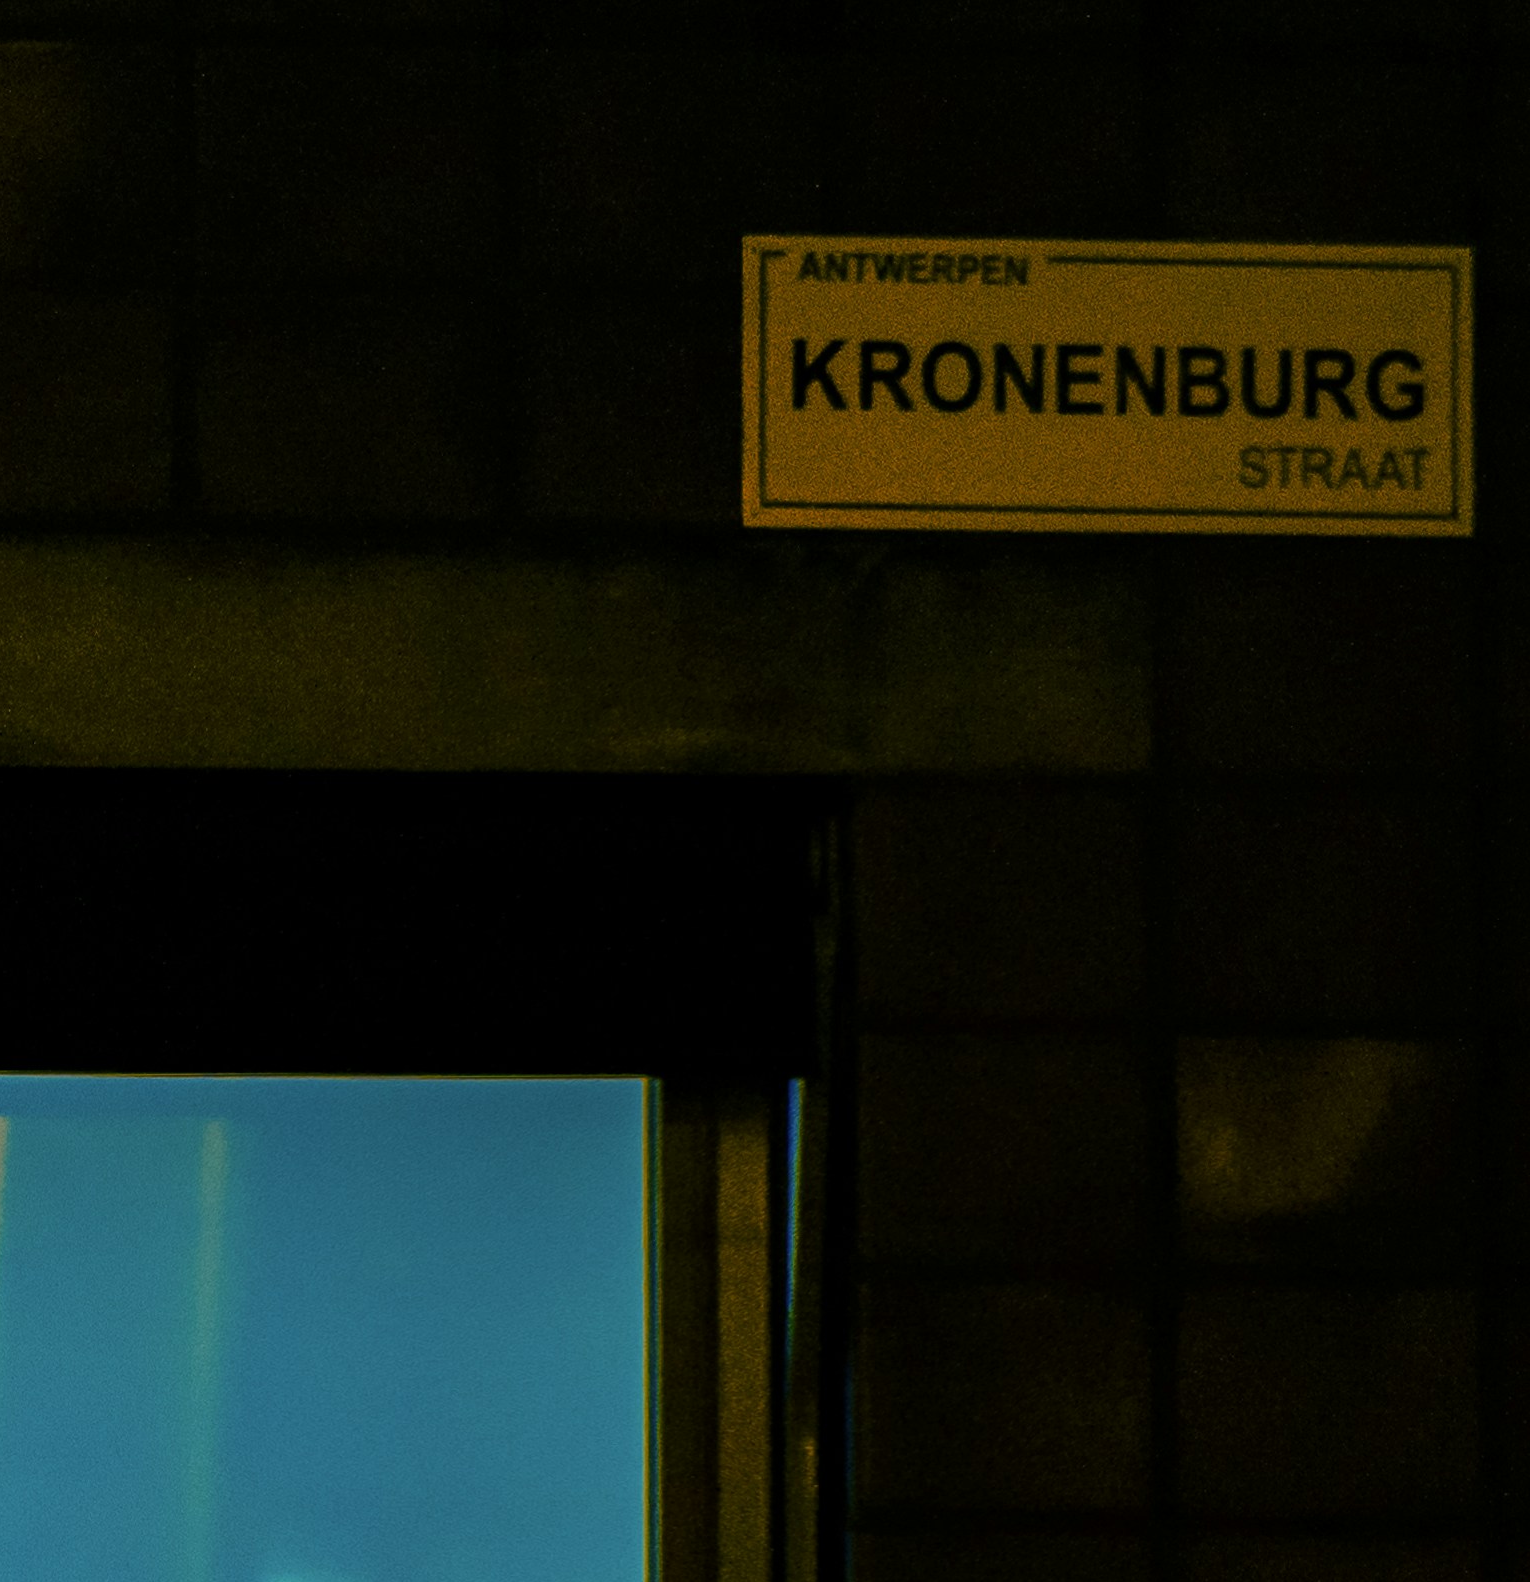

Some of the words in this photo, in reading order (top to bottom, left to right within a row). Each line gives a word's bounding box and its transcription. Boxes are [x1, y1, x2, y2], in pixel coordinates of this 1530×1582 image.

[795, 251, 1029, 286] ANTWERPEN
[790, 337, 1425, 421] KRONENBURG
[1238, 445, 1431, 491] STRAAT
